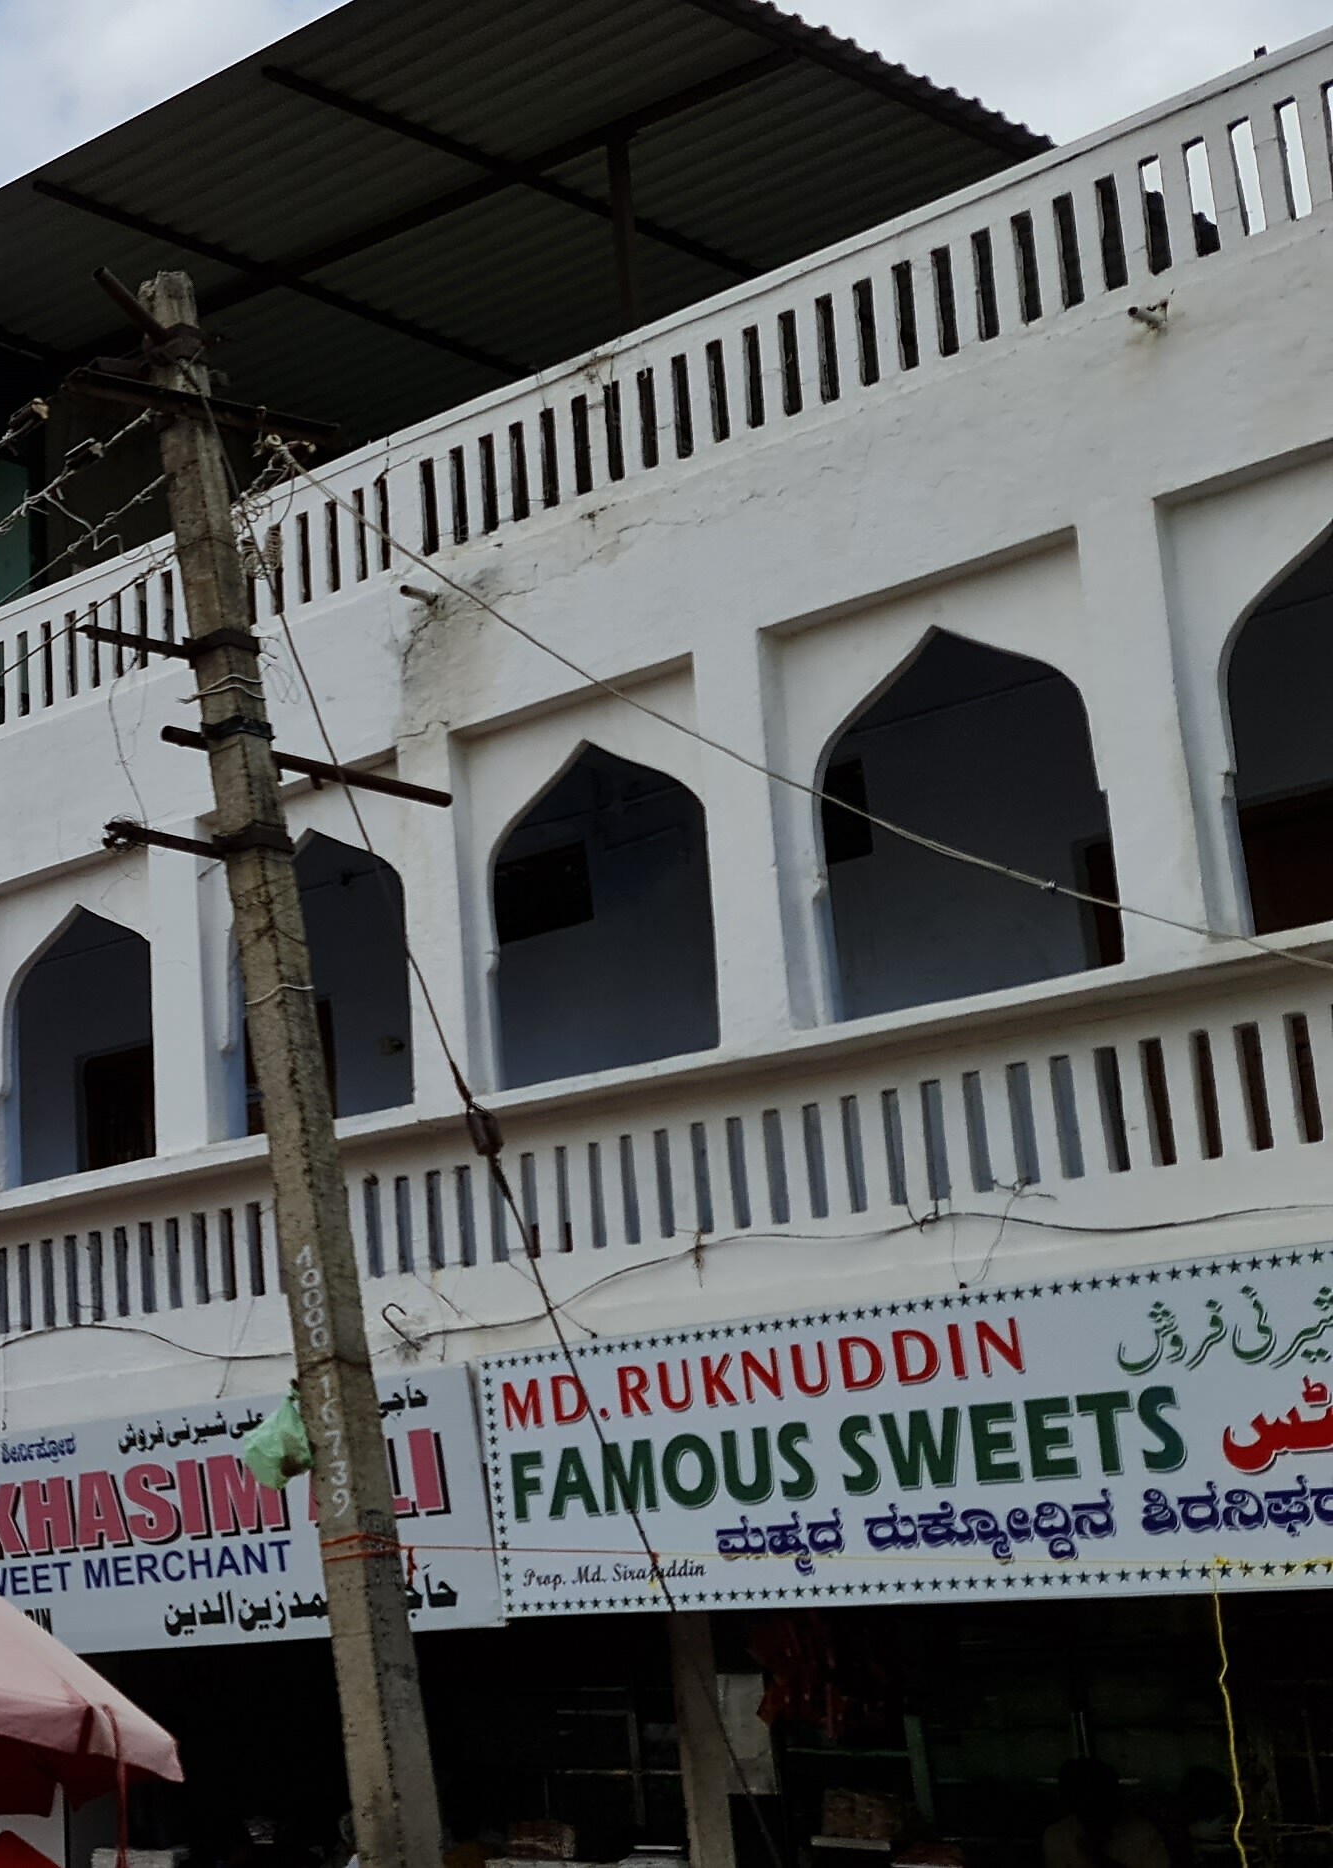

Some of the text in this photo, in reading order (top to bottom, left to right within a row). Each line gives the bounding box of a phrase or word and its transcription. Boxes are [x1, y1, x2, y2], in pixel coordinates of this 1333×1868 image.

[510, 1384, 1188, 1522] FAMOUS SWEETS
[82, 1540, 291, 1590] MERCHANT
